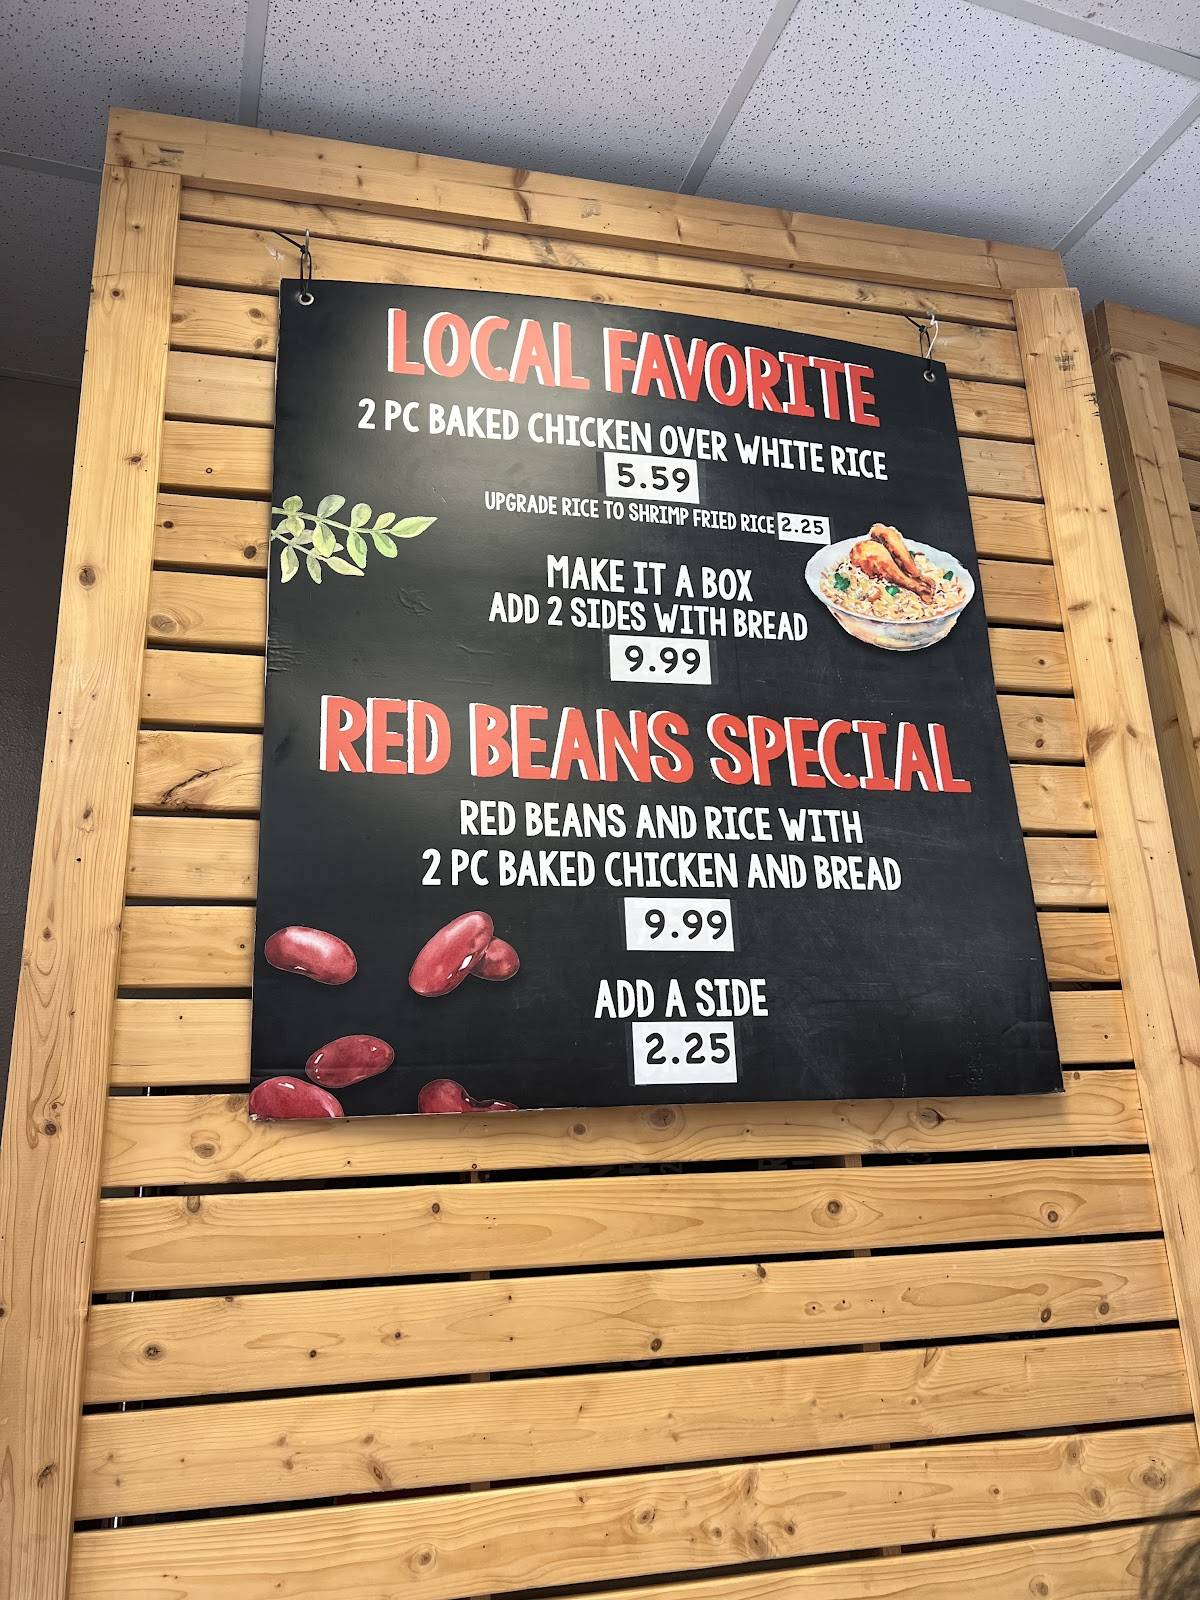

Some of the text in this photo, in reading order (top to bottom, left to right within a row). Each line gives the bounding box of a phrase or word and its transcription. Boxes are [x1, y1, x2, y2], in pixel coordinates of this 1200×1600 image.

[388, 308, 881, 427] LOCAL FAVORITE
[358, 398, 888, 480] 2 PC BAKED CHICKEN OVER WHITE RICE
[618, 463, 689, 492] 5.59
[484, 490, 823, 535] UPGRADE RICE TO SHRIMP FRIED RICE 2.25
[547, 555, 753, 602] MAKE IT A BOX
[489, 592, 807, 641] ADD 2 SIDES WITH BREAD
[625, 646, 700, 674] 9.99
[320, 695, 971, 792] RED BEANS SPECIAL
[461, 800, 863, 843] RED BEANS AND RICE WITH
[422, 849, 901, 890] 2 PC BAKED CHICKEN AND BREAD
[645, 910, 726, 939] 9.99
[595, 978, 768, 1018] ADD A SIDE
[646, 1033, 730, 1064] 2.25
